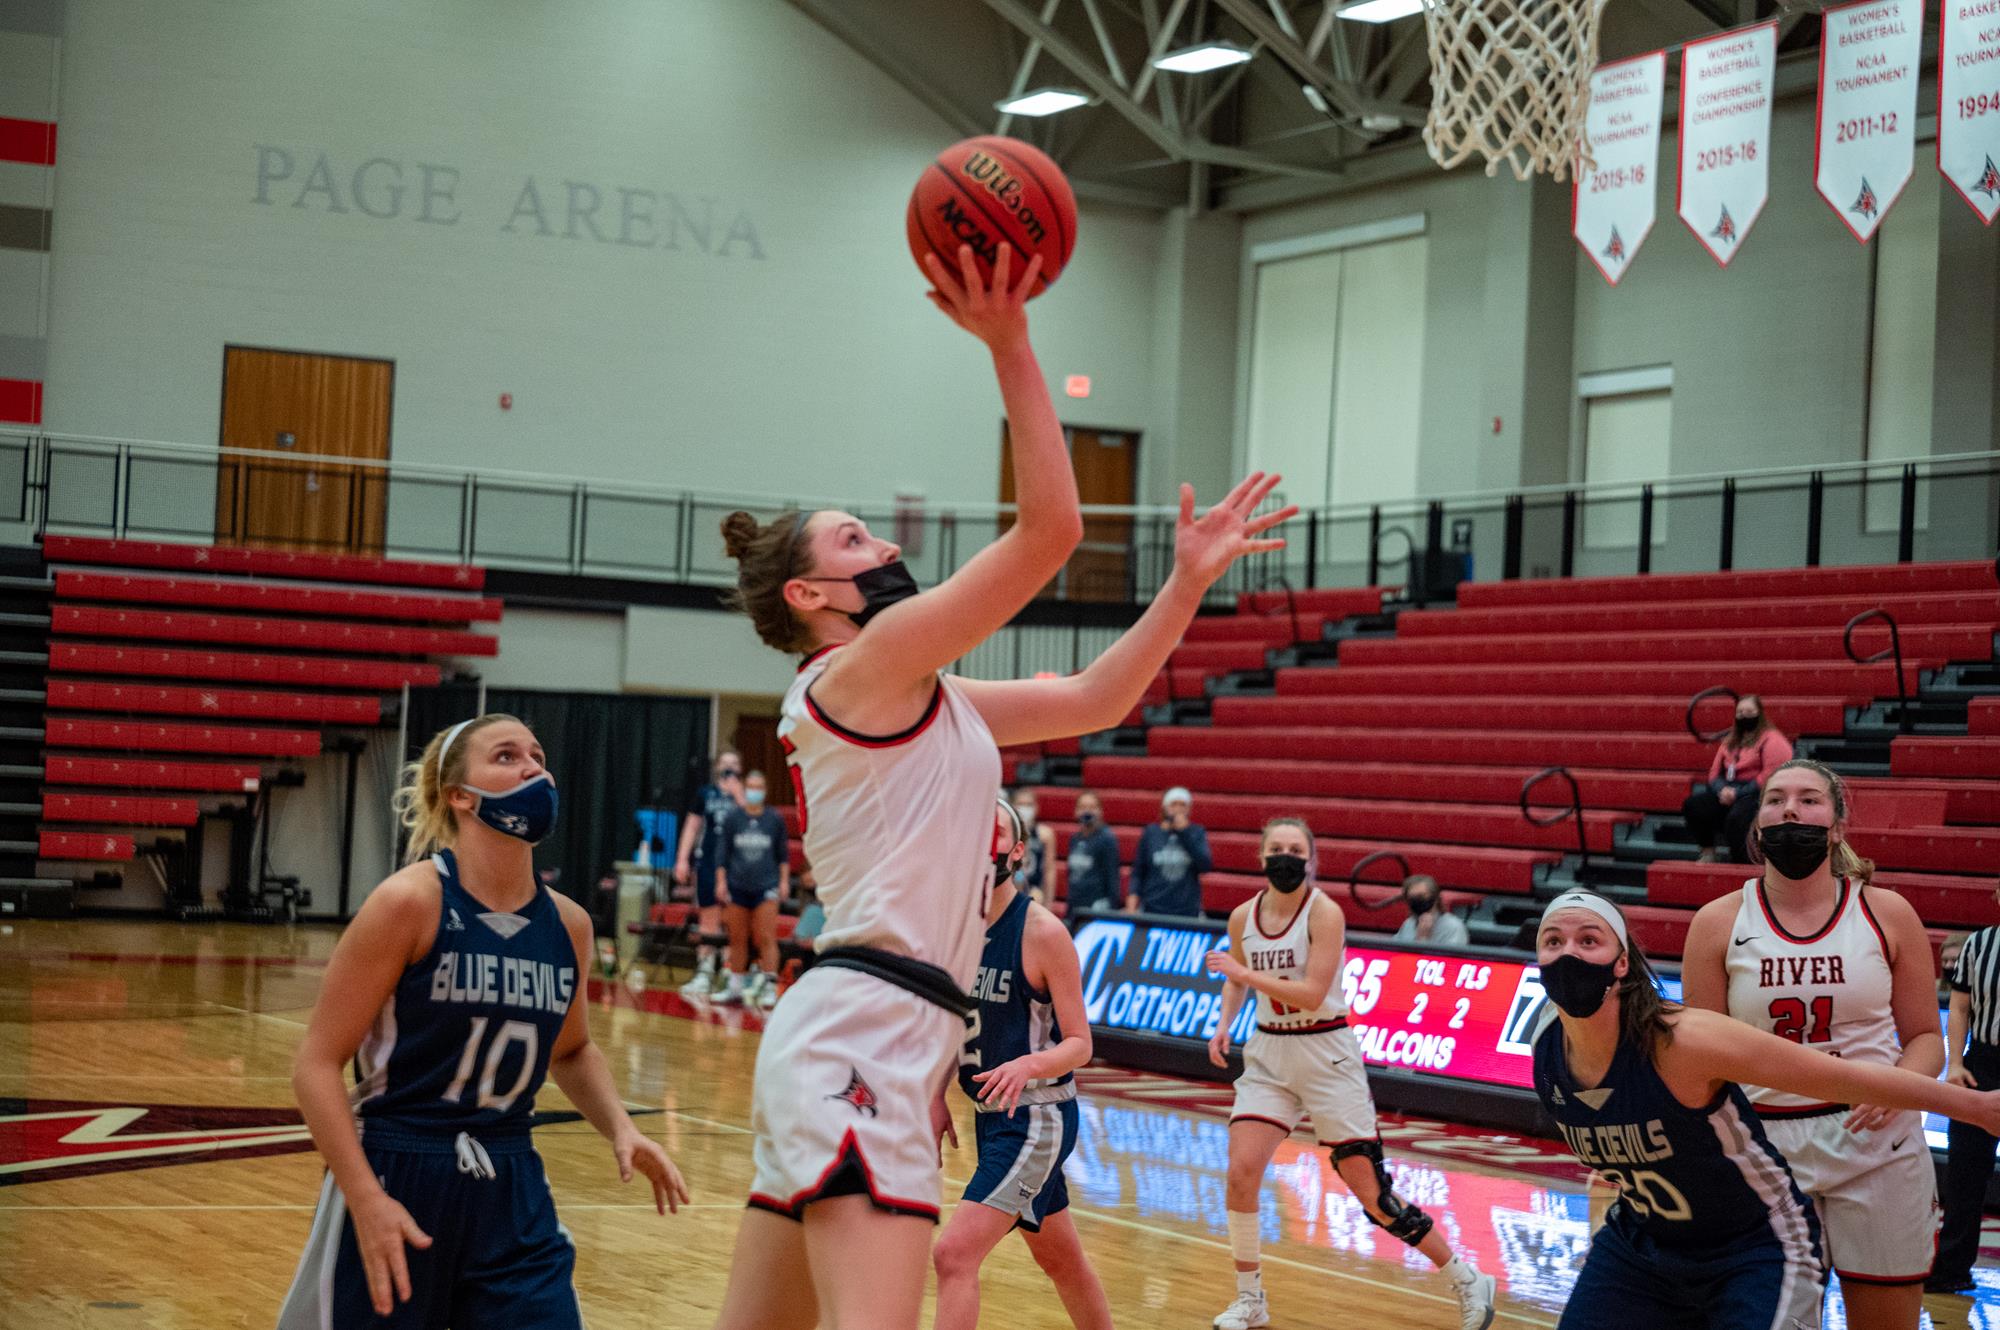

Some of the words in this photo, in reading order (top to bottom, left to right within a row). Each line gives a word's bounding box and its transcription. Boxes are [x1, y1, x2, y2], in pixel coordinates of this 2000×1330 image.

[1848, 5, 1899, 25] WOMEN'S
[1959, 0, 2000, 20] BASKE
[1838, 22, 1907, 47] BASKETBALL
[1707, 39, 1754, 61] WOMEN'S
[1856, 52, 1887, 70] NCAA
[1601, 67, 1644, 86] WOMEN'S
[1699, 55, 1760, 80] BASKETBALL
[1835, 65, 1909, 92] TOURNAMENT
[1593, 83, 1649, 106] BASKETBALL
[1697, 79, 1762, 106] CONFERENCE
[1958, 91, 2000, 120] 1994
[1608, 110, 1632, 126] NCAA
[1692, 95, 1766, 124] CHAMPIONSHIP
[1591, 122, 1651, 146] TOURNAMENT
[1836, 112, 1898, 144] 2011-12
[1697, 139, 1757, 172] 2015-16
[1590, 164, 1645, 193] 2015-16
[251, 143, 463, 226] PAGE
[500, 175, 768, 261] ARENA
[961, 151, 1046, 244] Wilson
[937, 198, 1000, 266] NCAA
[1140, 928, 1213, 976] TWIN
[1251, 948, 1296, 971] RIVER
[430, 951, 499, 1004] BLUE
[502, 956, 574, 1016] DEVILS
[971, 966, 1013, 1003] EVILS
[1341, 957, 1390, 1015] 65
[1413, 959, 1446, 986] TOL
[1455, 963, 1491, 990] FLS
[1759, 955, 1846, 988] RIVER
[1407, 992, 1428, 1024] 2
[1449, 997, 1470, 1029] 2
[1768, 996, 1833, 1044] 21
[1353, 1024, 1456, 1069] FALCONS
[440, 1016, 539, 1112] 10
[1594, 1118, 1674, 1164] DEVILS
